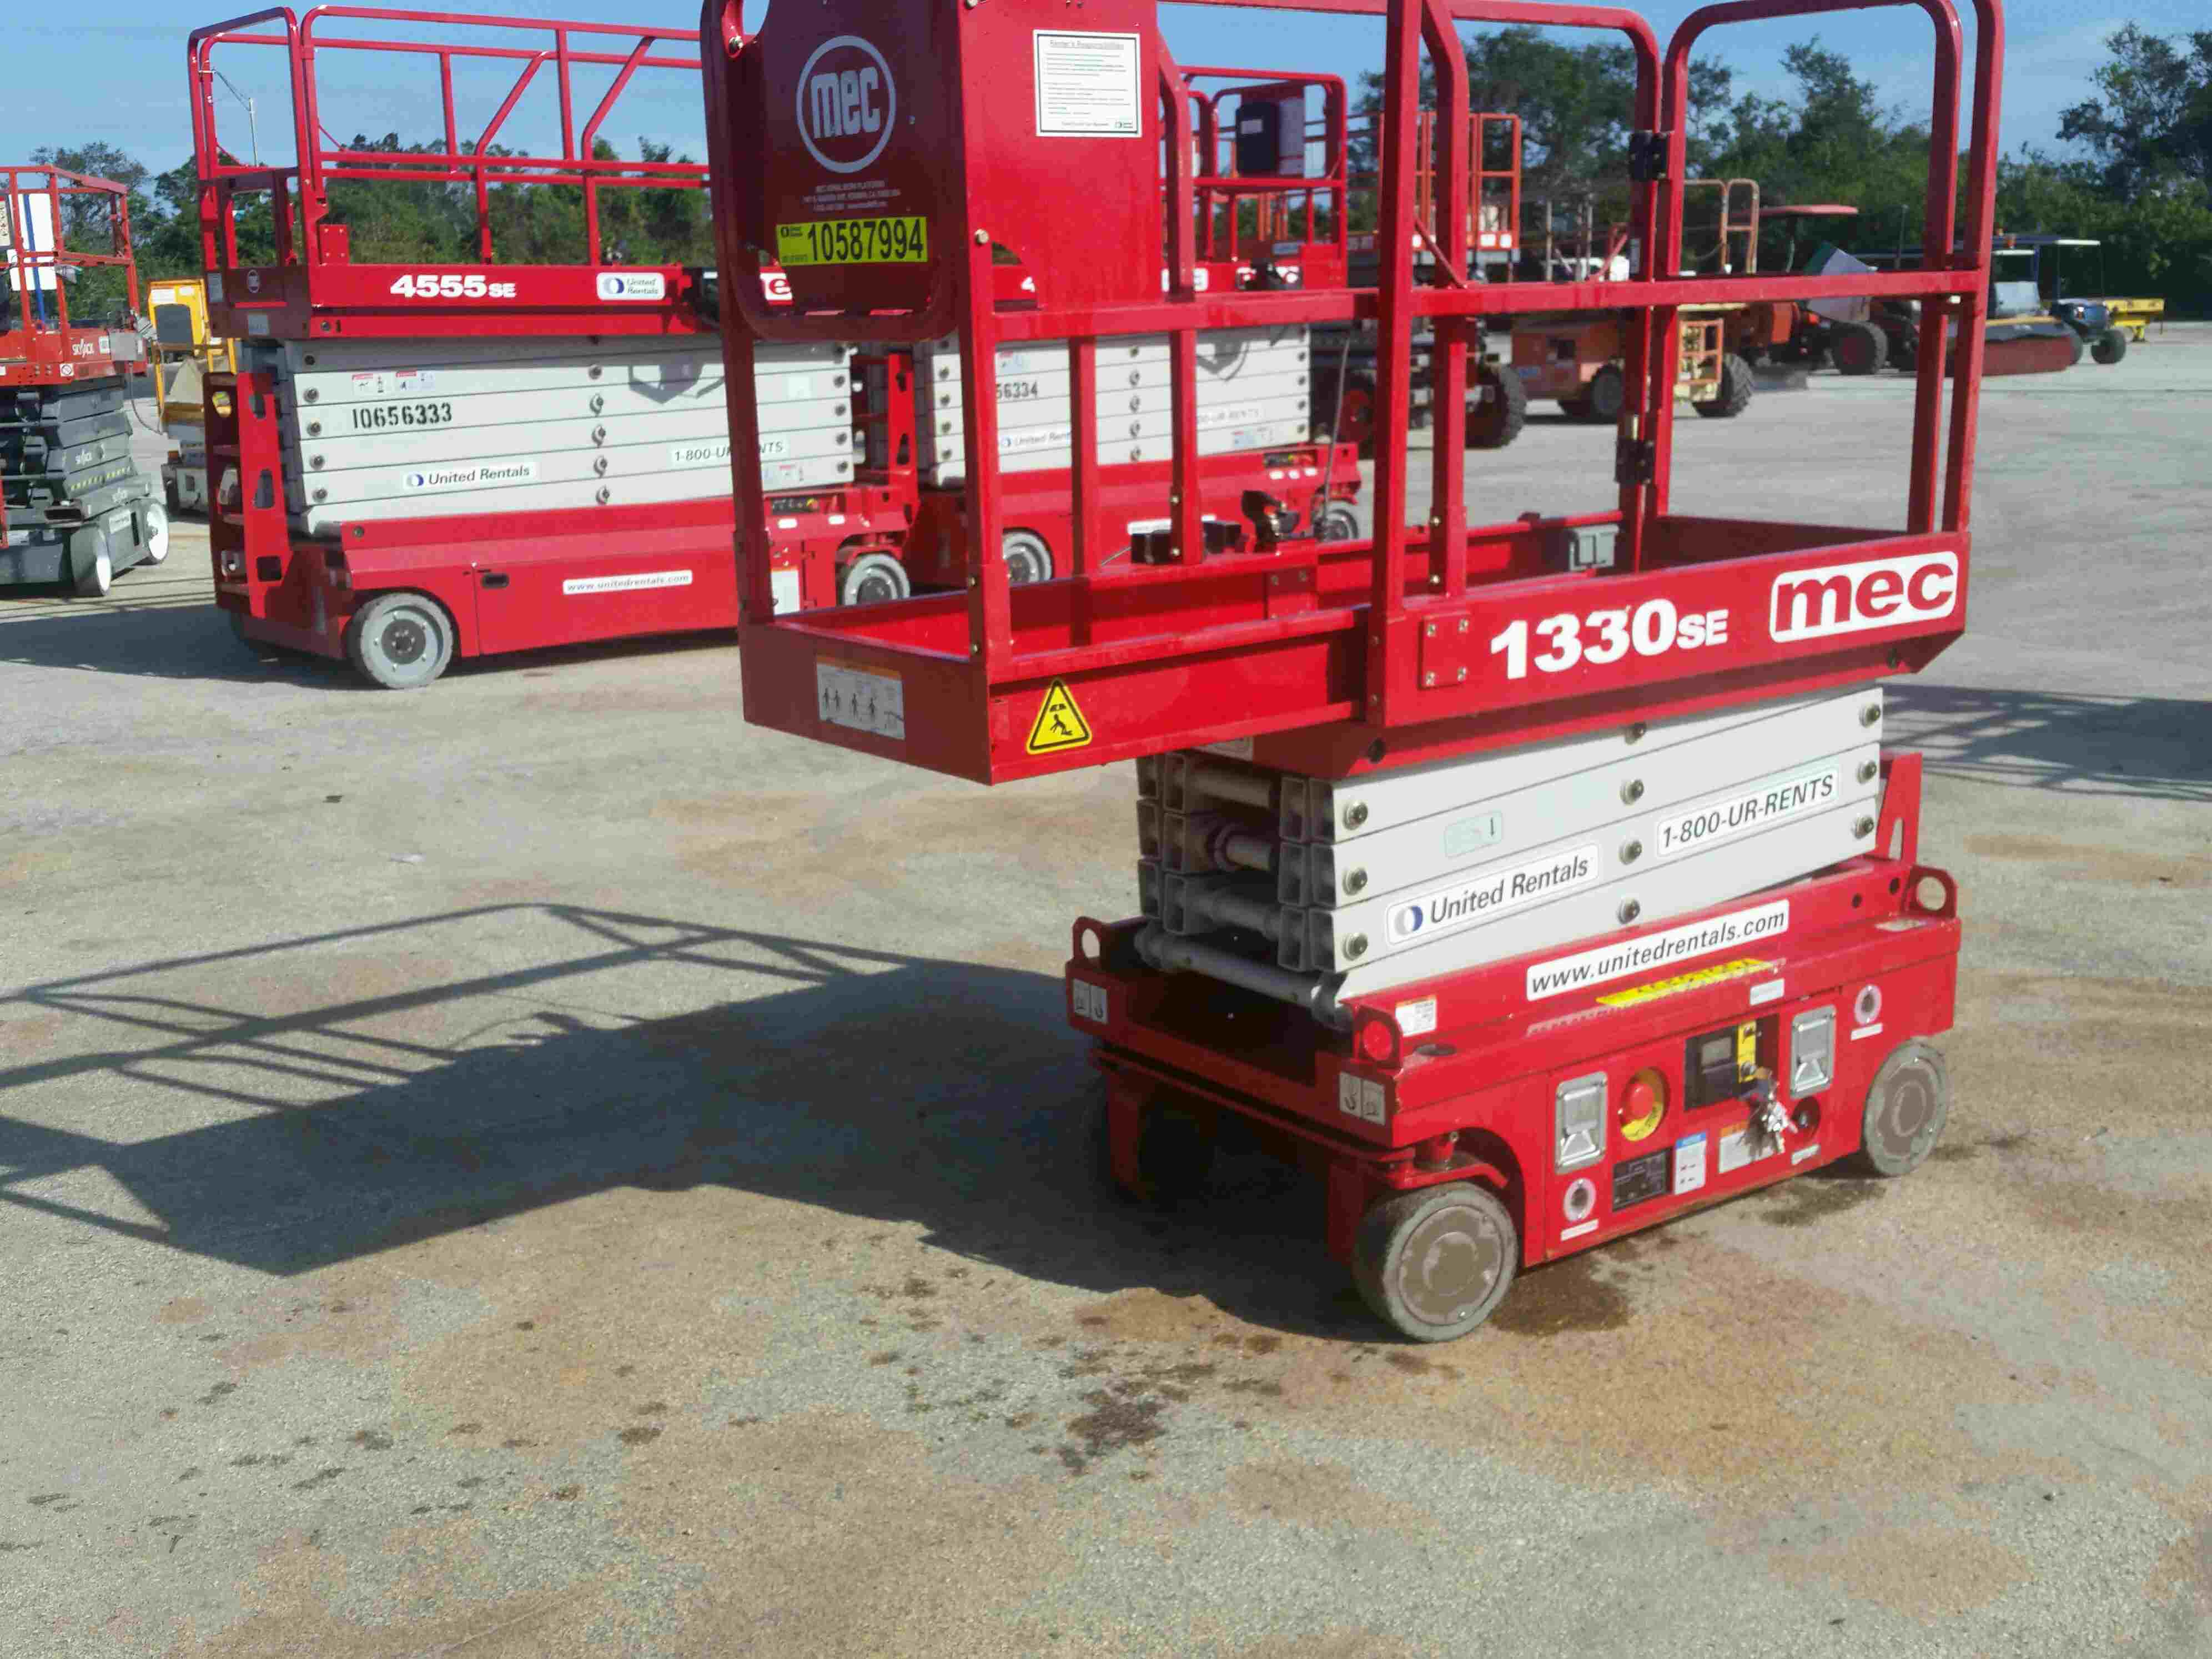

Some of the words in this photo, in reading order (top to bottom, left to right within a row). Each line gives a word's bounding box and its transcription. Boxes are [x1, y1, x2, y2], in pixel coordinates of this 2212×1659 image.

[808, 219, 923, 261] 10587994
[390, 274, 516, 298] 4555SE
[352, 403, 453, 429] 10656333
[429, 471, 476, 485] United
[480, 465, 530, 480] Rentals
[1490, 598, 1728, 681] 1330SE
[1663, 774, 1833, 848] 1-800-UR-RENTS
[1430, 879, 1505, 923] United
[1511, 856, 1588, 898] Rentals
[1531, 912, 1785, 994] www.unitedrentals.com
